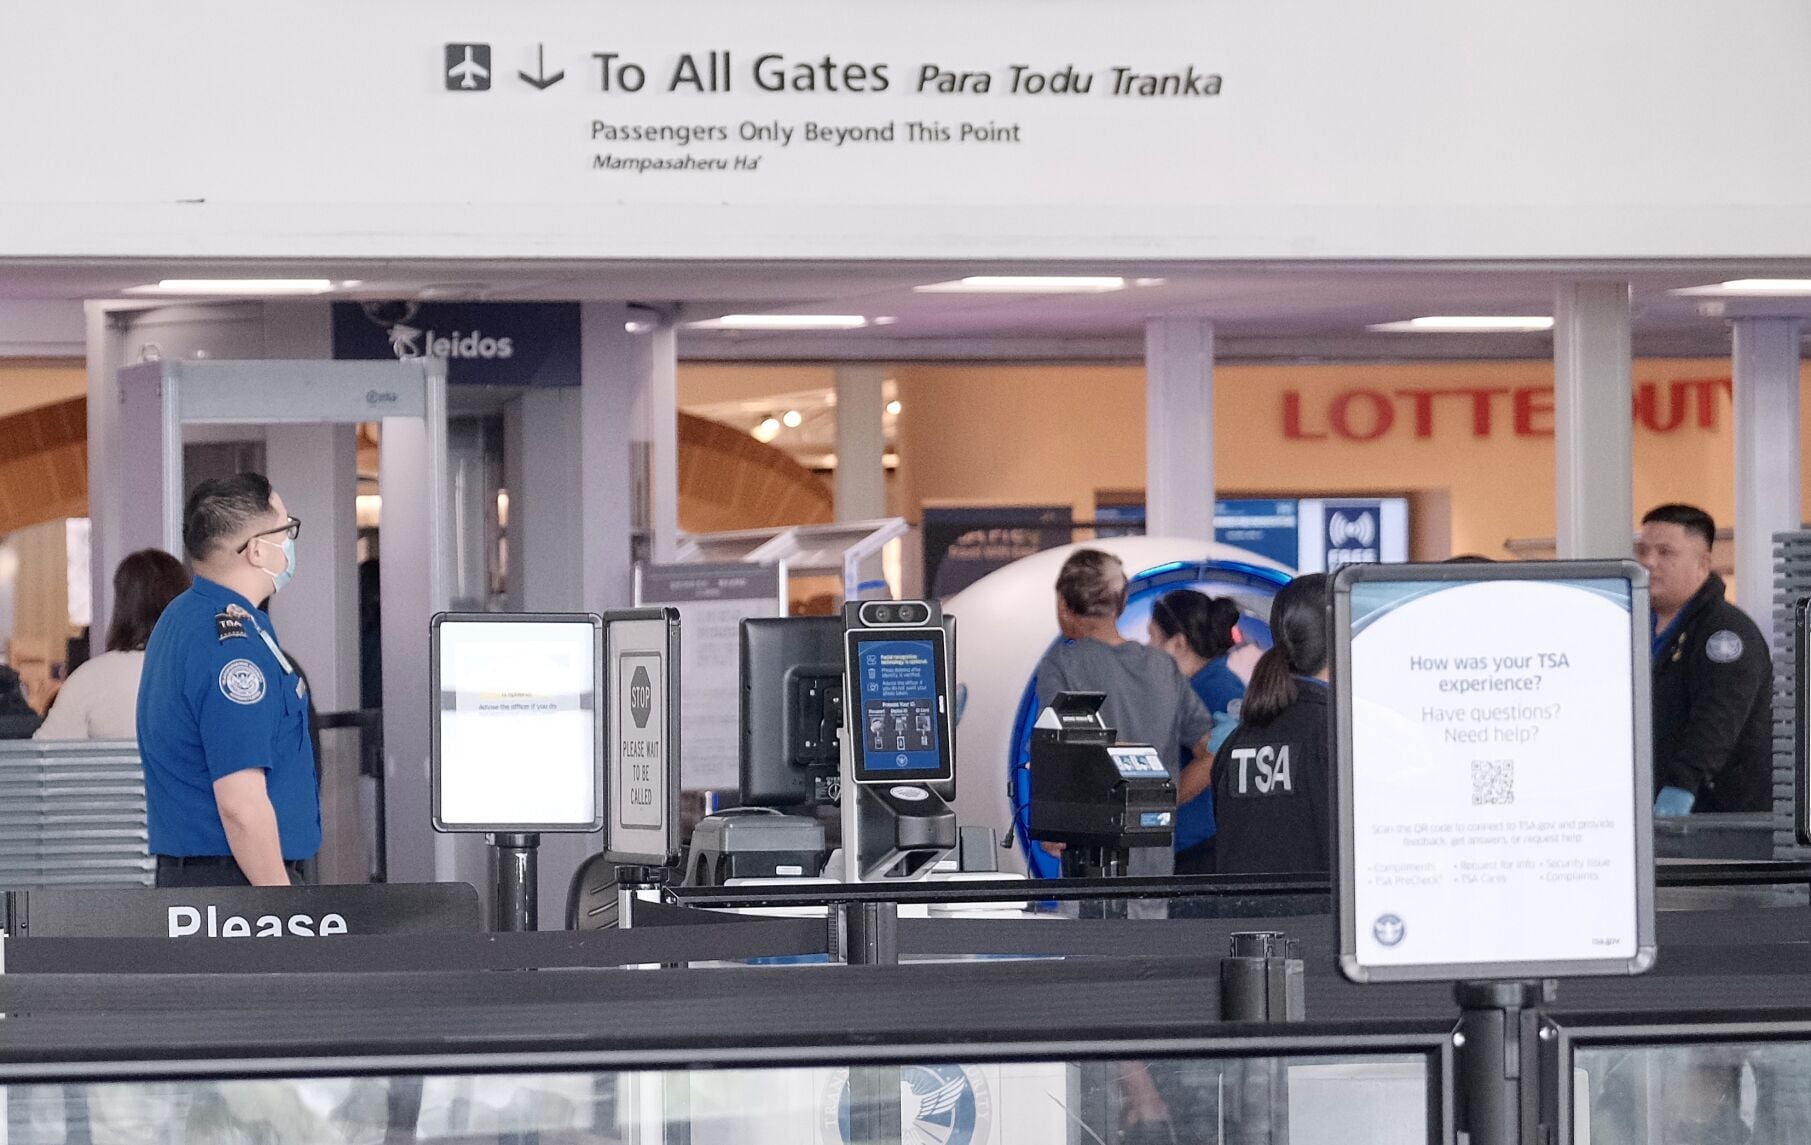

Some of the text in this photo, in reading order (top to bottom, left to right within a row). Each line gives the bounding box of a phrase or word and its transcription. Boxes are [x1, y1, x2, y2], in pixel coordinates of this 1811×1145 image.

[592, 51, 889, 92] To All Gates
[917, 64, 1222, 96] Para Todu Tranka
[592, 120, 1021, 146] Passengers Only Beyond This Point
[592, 154, 727, 173] Mampasaheru
[425, 330, 514, 358] leidos
[1283, 377, 1733, 442] LOTTE UT
[1410, 653, 1570, 673] How was your TSA
[1439, 675, 1542, 694] experience?
[631, 686, 650, 709] STOP
[1421, 703, 1561, 723] Have questions?
[1444, 726, 1540, 744] Need help?
[623, 741, 659, 757] PLEASE WAIT
[632, 764, 649, 781] TO BE
[1231, 744, 1292, 793] TSA
[630, 789, 652, 805] CALLED
[168, 905, 348, 938] Please
